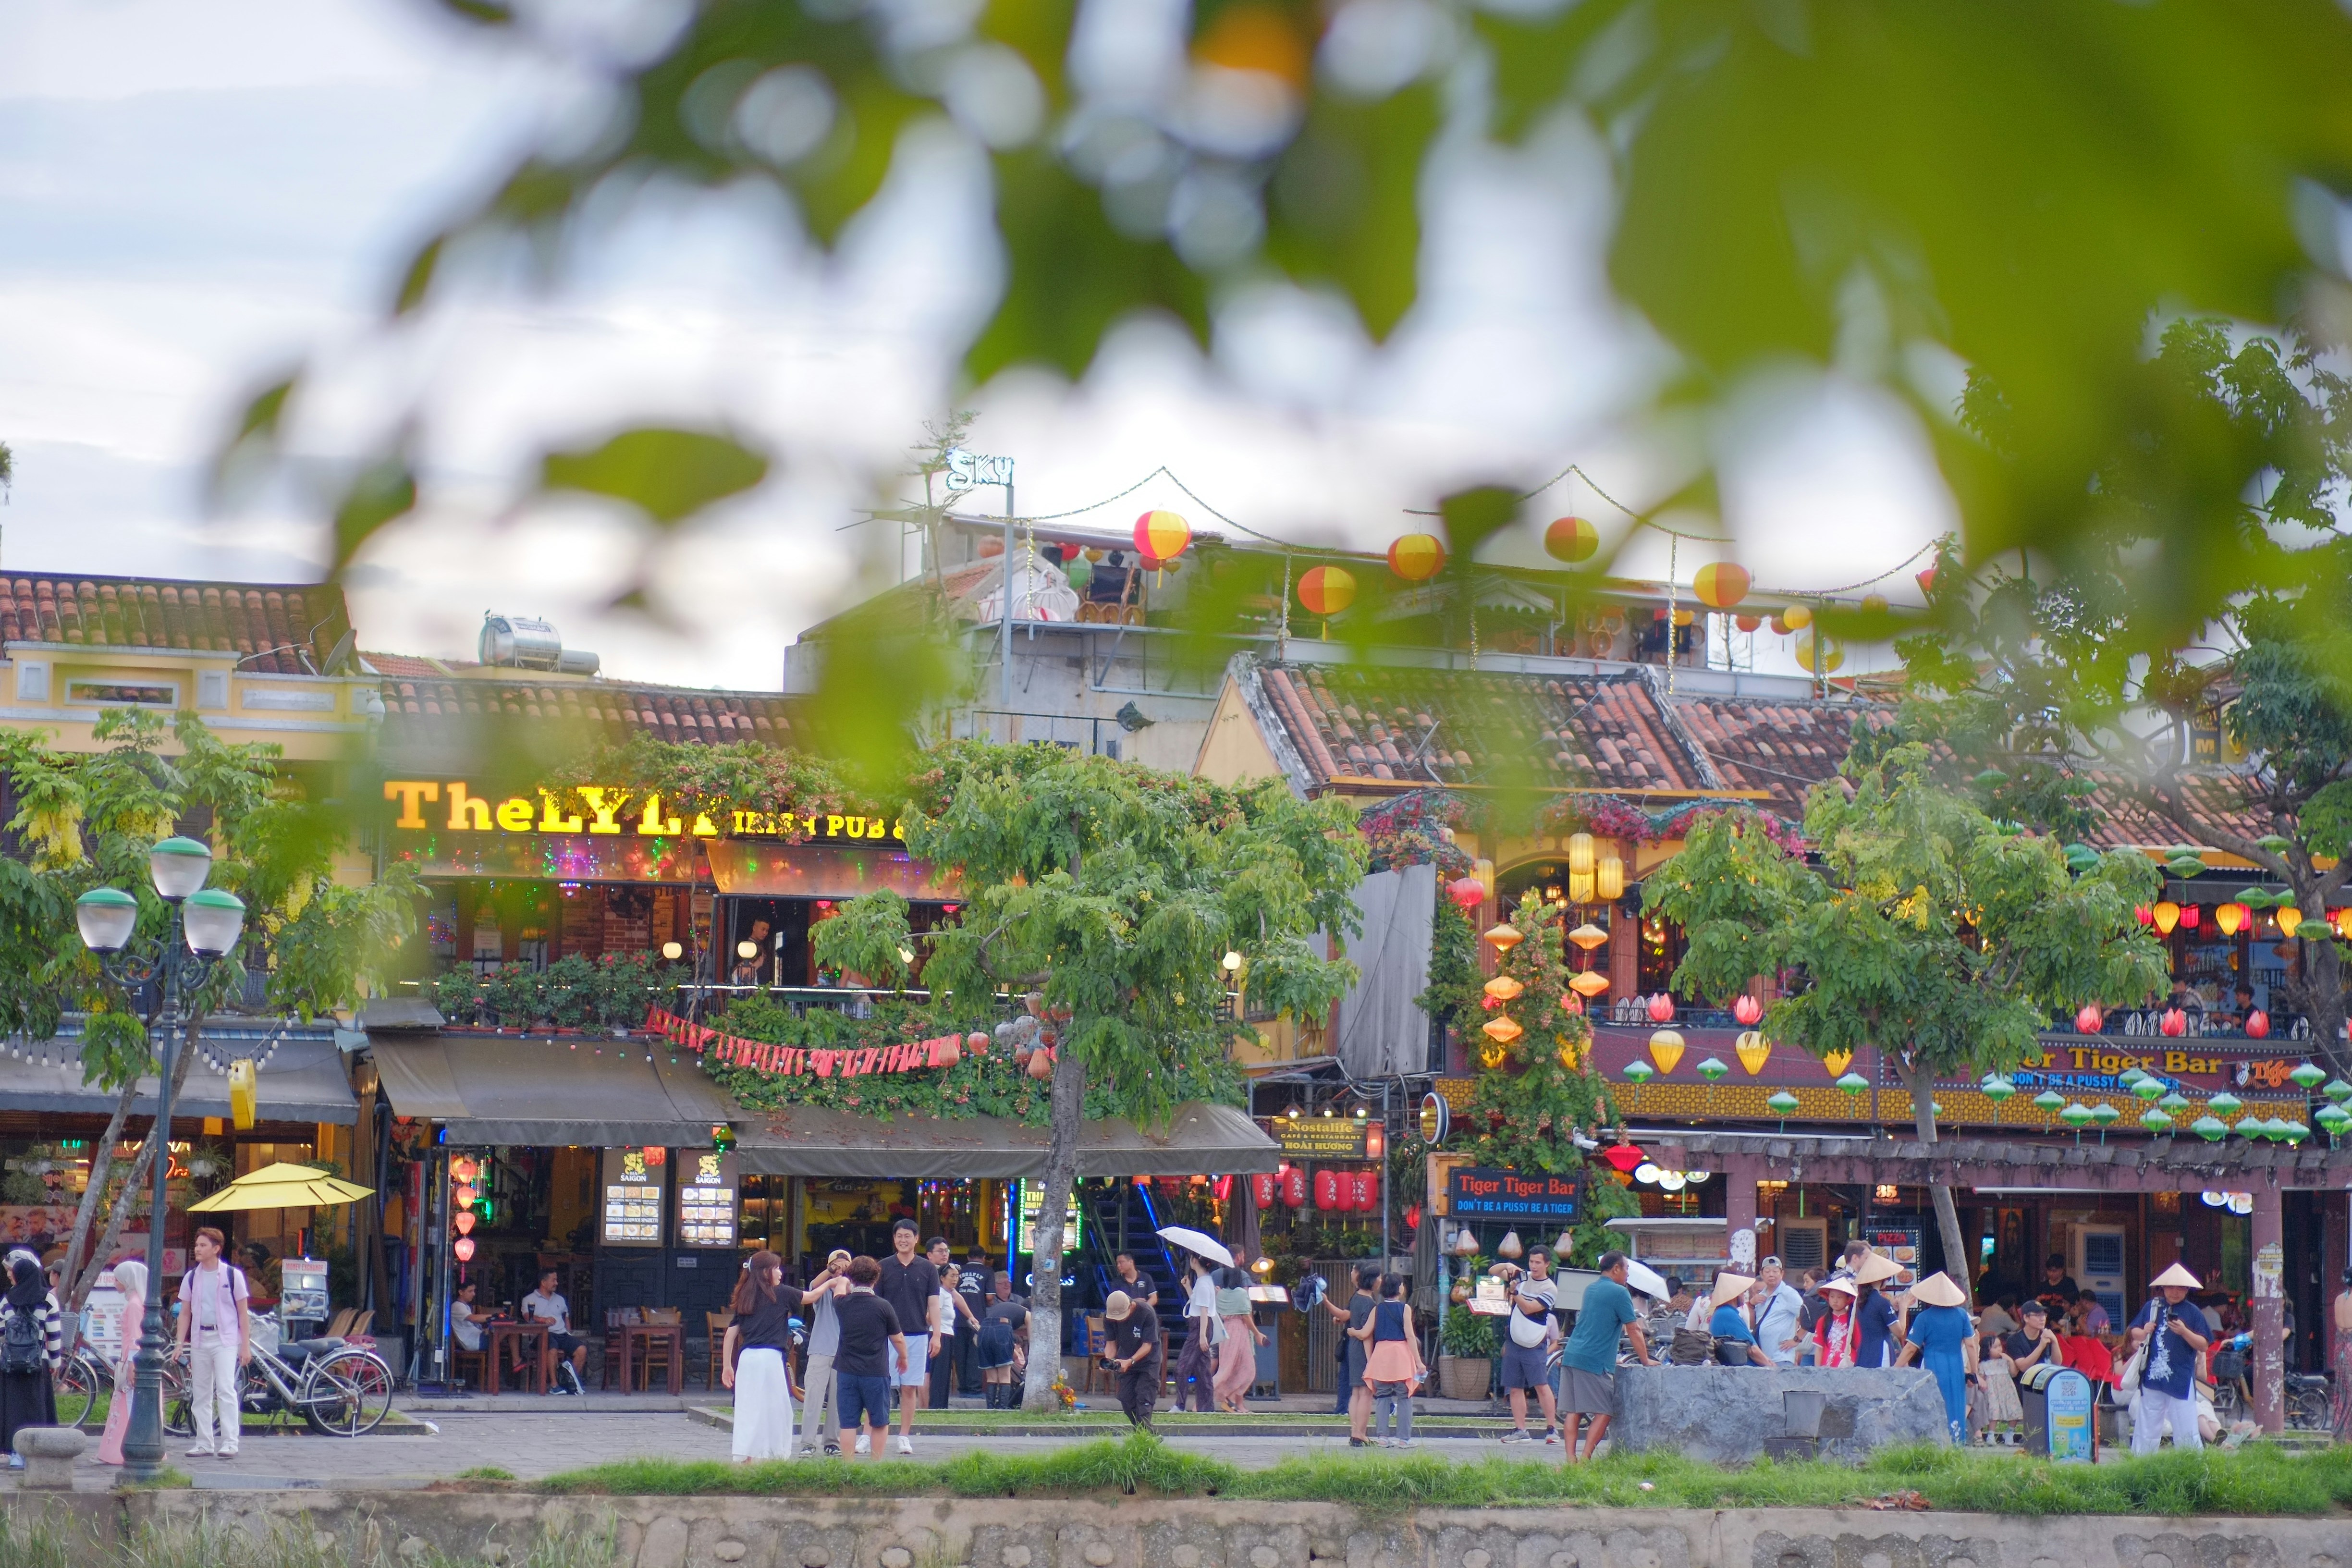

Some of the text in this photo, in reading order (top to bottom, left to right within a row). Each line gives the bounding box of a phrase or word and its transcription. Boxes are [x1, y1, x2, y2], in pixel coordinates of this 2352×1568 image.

[946, 445, 1014, 490] SKY
[827, 815, 885, 839] PUB
[2068, 1047, 2155, 1074] Tiger
[2165, 1050, 2222, 1074] Bar
[2252, 1059, 2301, 1088] Tige
[2048, 1074, 2063, 1086] BE
[2066, 1075, 2073, 1087] A
[2077, 1076, 2115, 1088] PUSSY
[1288, 1122, 1353, 1133] Nostalife
[1285, 1141, 1353, 1150] HOÀI HƯƠNG
[1459, 1175, 1575, 1197] Tiger Tiger Bar
[1875, 1184, 1898, 1198] 35
[1458, 1199, 1572, 1213] DON'T BE A PUSSY BE A TIGER
[1877, 1233, 1907, 1242] PIZZA
